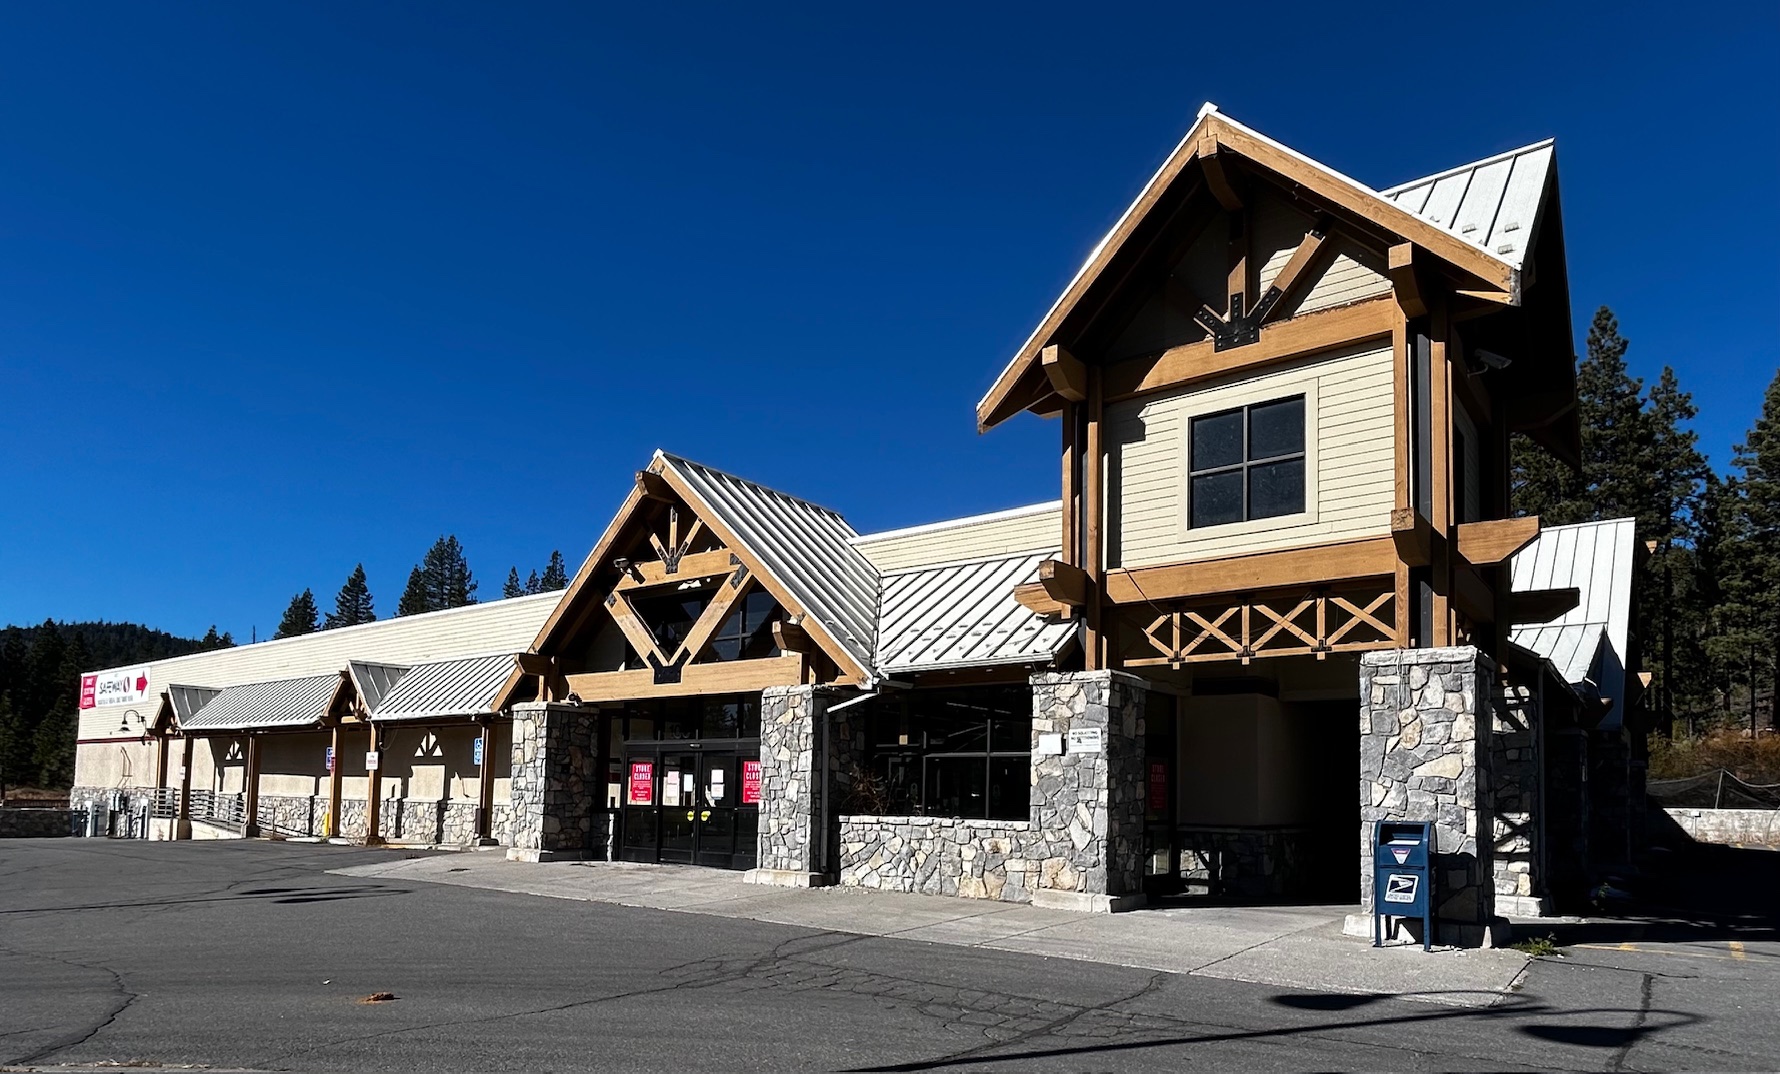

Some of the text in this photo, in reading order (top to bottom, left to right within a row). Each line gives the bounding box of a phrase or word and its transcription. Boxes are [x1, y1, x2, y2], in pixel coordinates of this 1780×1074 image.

[99, 680, 123, 694] SAFEWAY
[635, 764, 650, 772] STORE
[748, 763, 761, 771] STOR
[634, 772, 651, 780] CLOSED
[746, 772, 760, 780] CLOS
